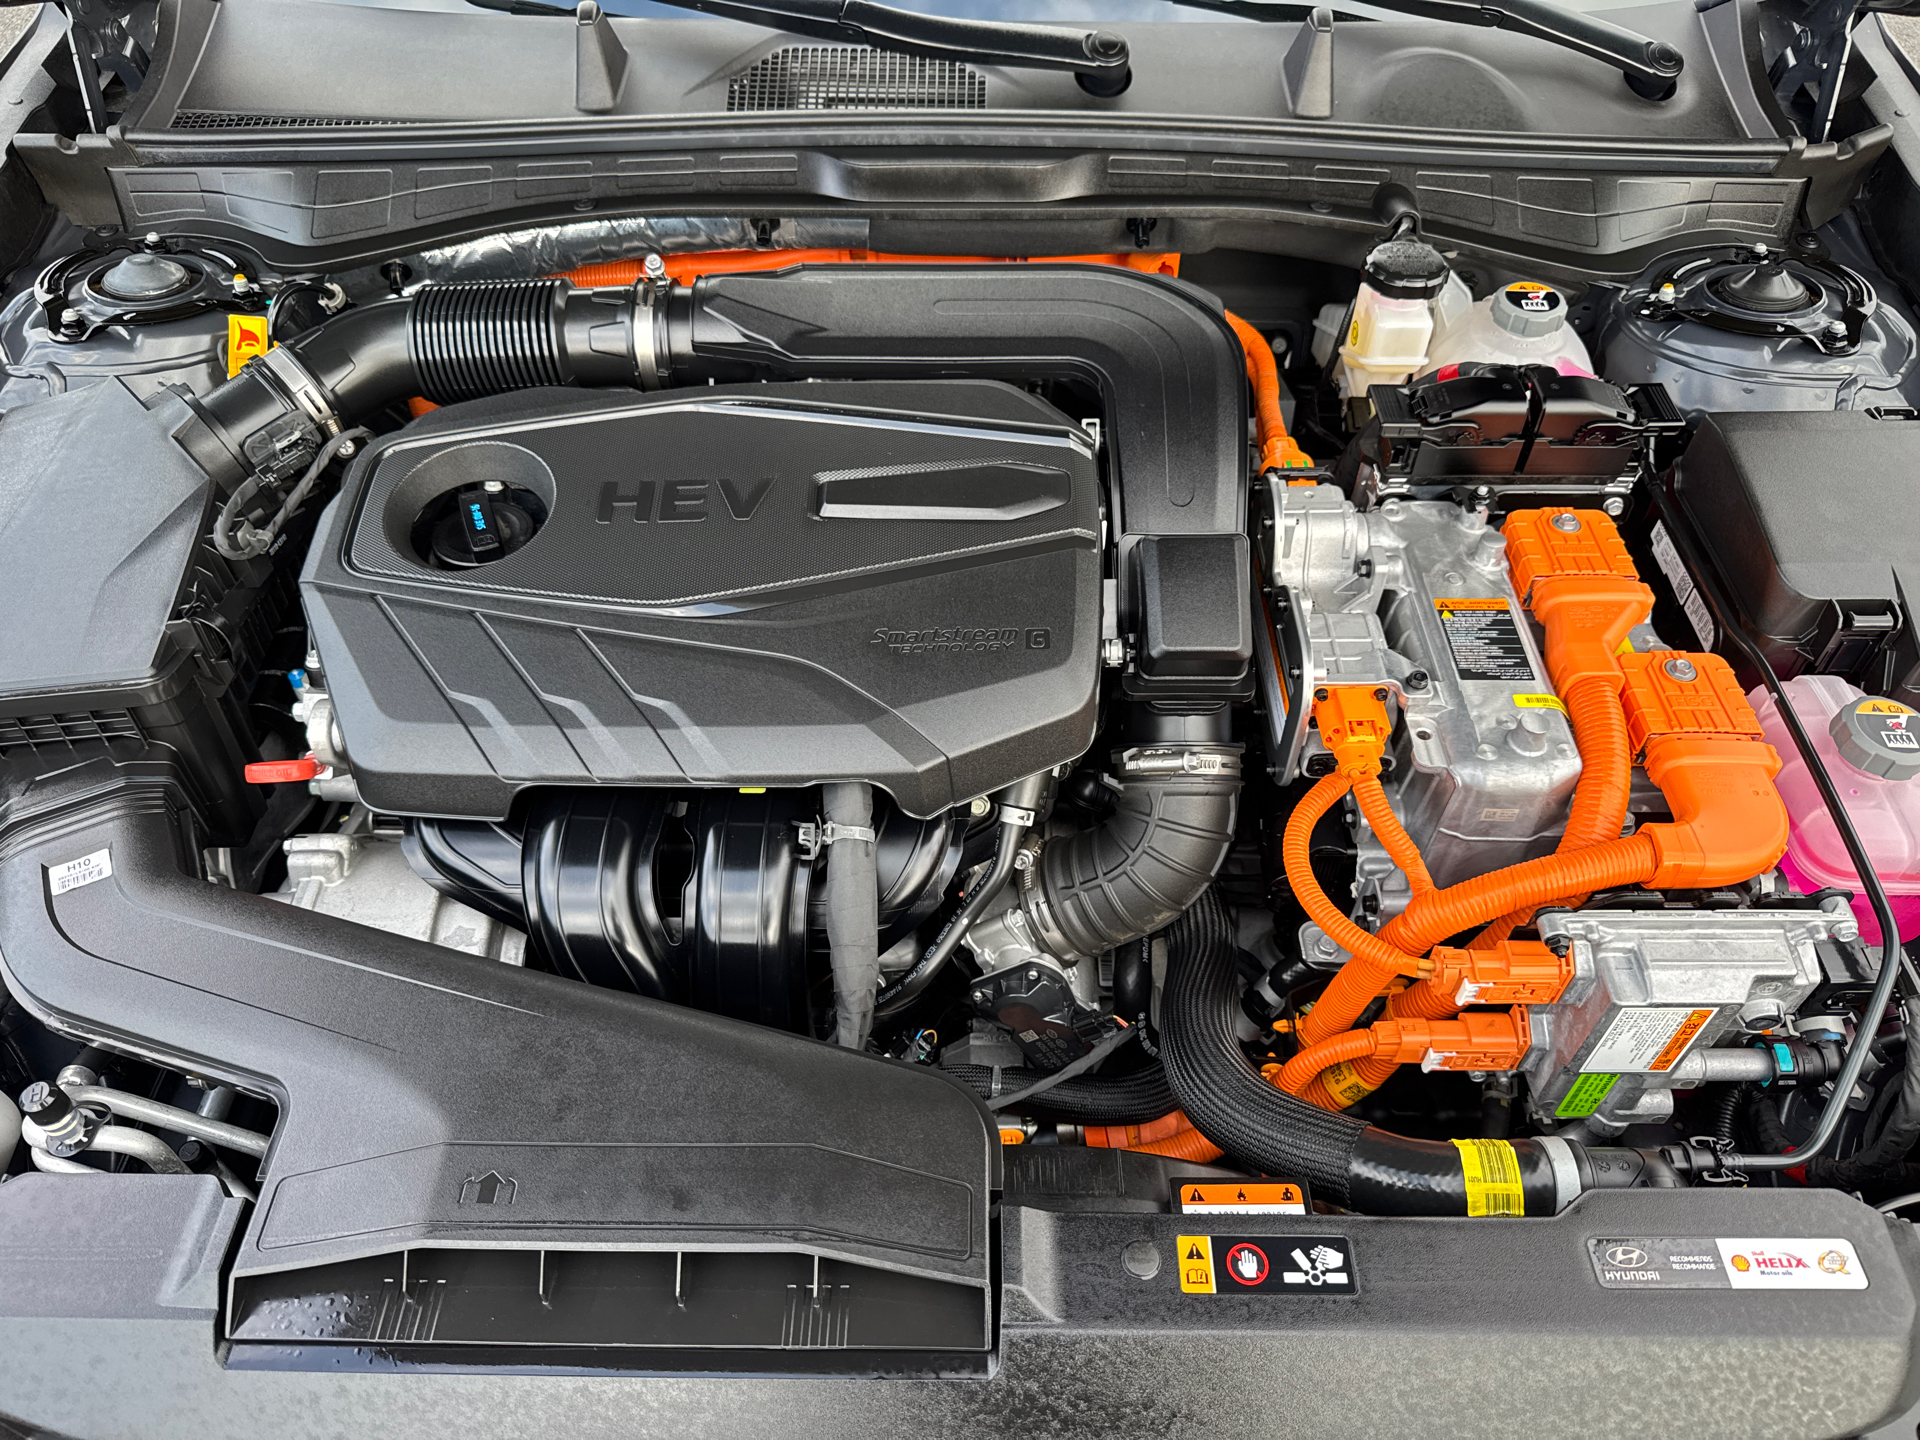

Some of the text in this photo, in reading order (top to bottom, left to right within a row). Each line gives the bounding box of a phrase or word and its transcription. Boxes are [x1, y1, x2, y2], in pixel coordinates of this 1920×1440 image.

[596, 476, 777, 524] HEV
[870, 626, 1048, 649] Smartstream G
[888, 641, 1015, 653] TECHNOLOGY
[1673, 696, 1714, 707] HSG
[1669, 1255, 1713, 1263] RECOMMENDS
[1755, 1258, 1809, 1269] HELIX
[1605, 1271, 1661, 1280] HYUNDAI
